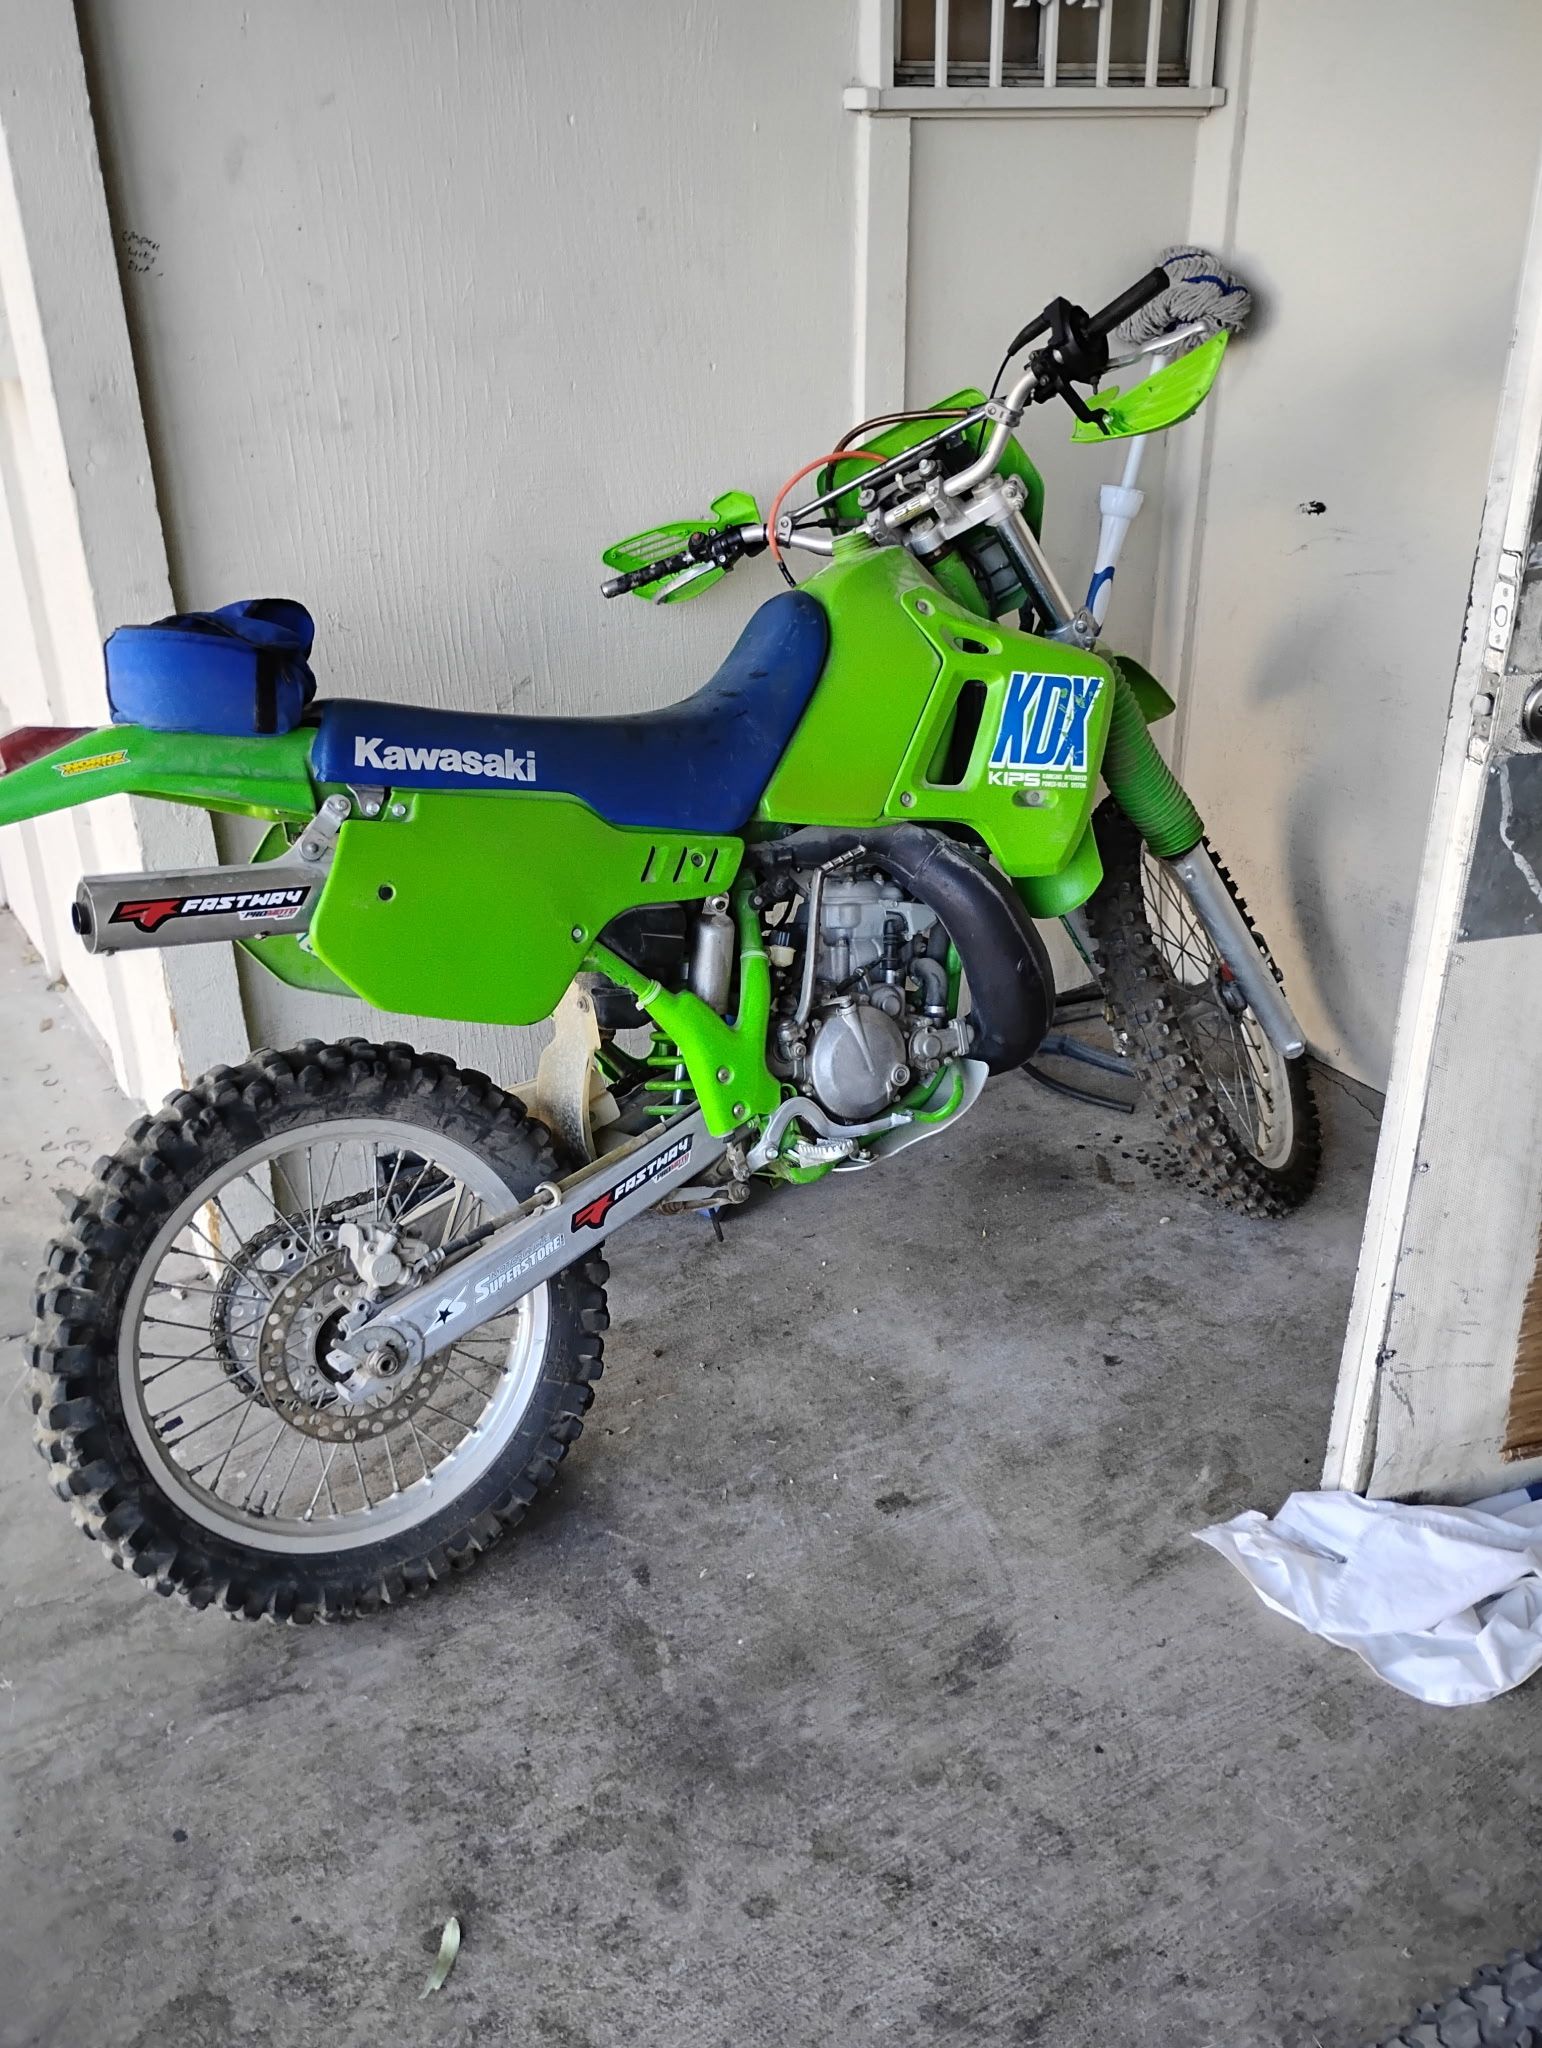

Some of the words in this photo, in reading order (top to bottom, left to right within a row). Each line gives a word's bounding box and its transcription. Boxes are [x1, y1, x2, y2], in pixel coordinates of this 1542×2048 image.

[988, 671, 1104, 772] KDX
[354, 736, 537, 782] Kawasaki
[988, 771, 1041, 787] KIPS
[180, 889, 303, 914] FASTWAY
[614, 1137, 688, 1201] FASTWAY
